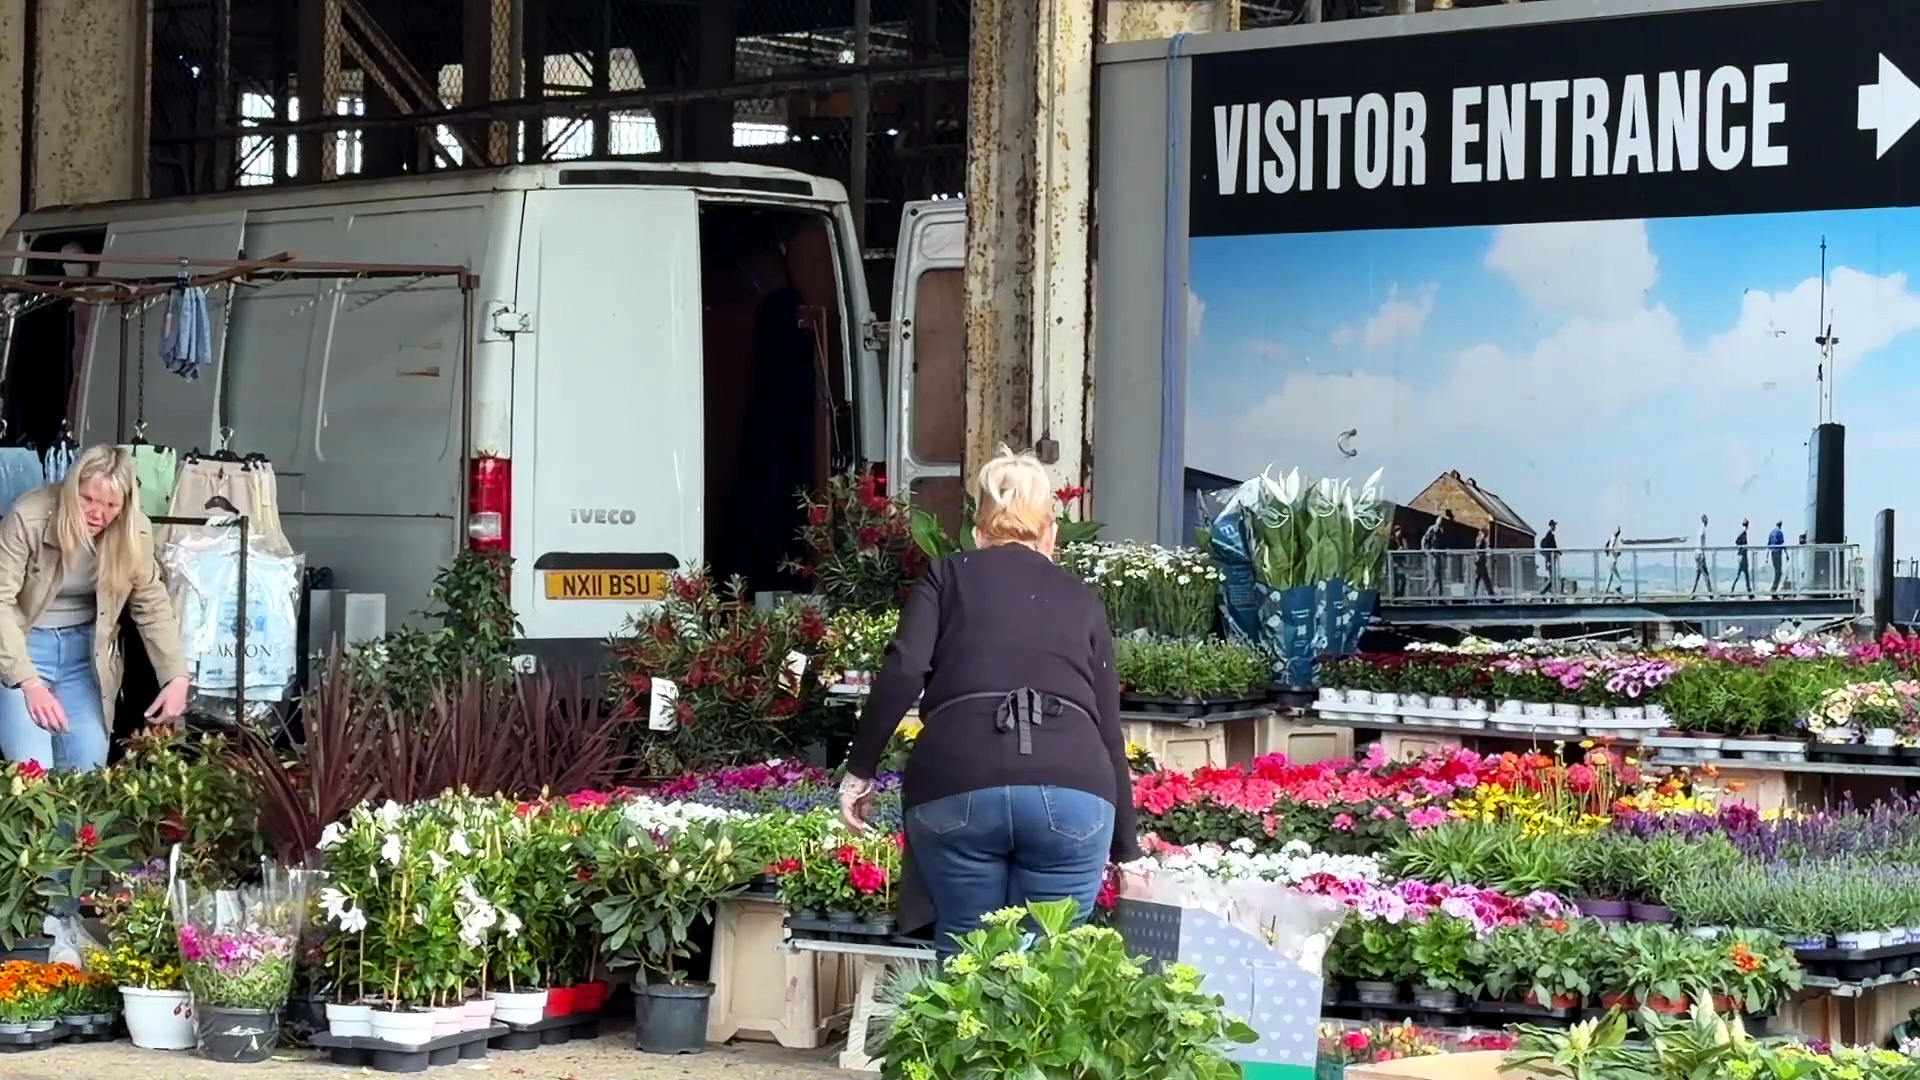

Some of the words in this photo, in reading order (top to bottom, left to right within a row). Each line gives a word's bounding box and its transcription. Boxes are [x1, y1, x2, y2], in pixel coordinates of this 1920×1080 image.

[1213, 92, 1427, 195] VISITOR
[1450, 62, 1790, 184] ENTRANCE
[571, 508, 636, 525] IVECO
[562, 574, 602, 596] NX11
[609, 574, 650, 596] BSU
[217, 643, 273, 658] AKON
